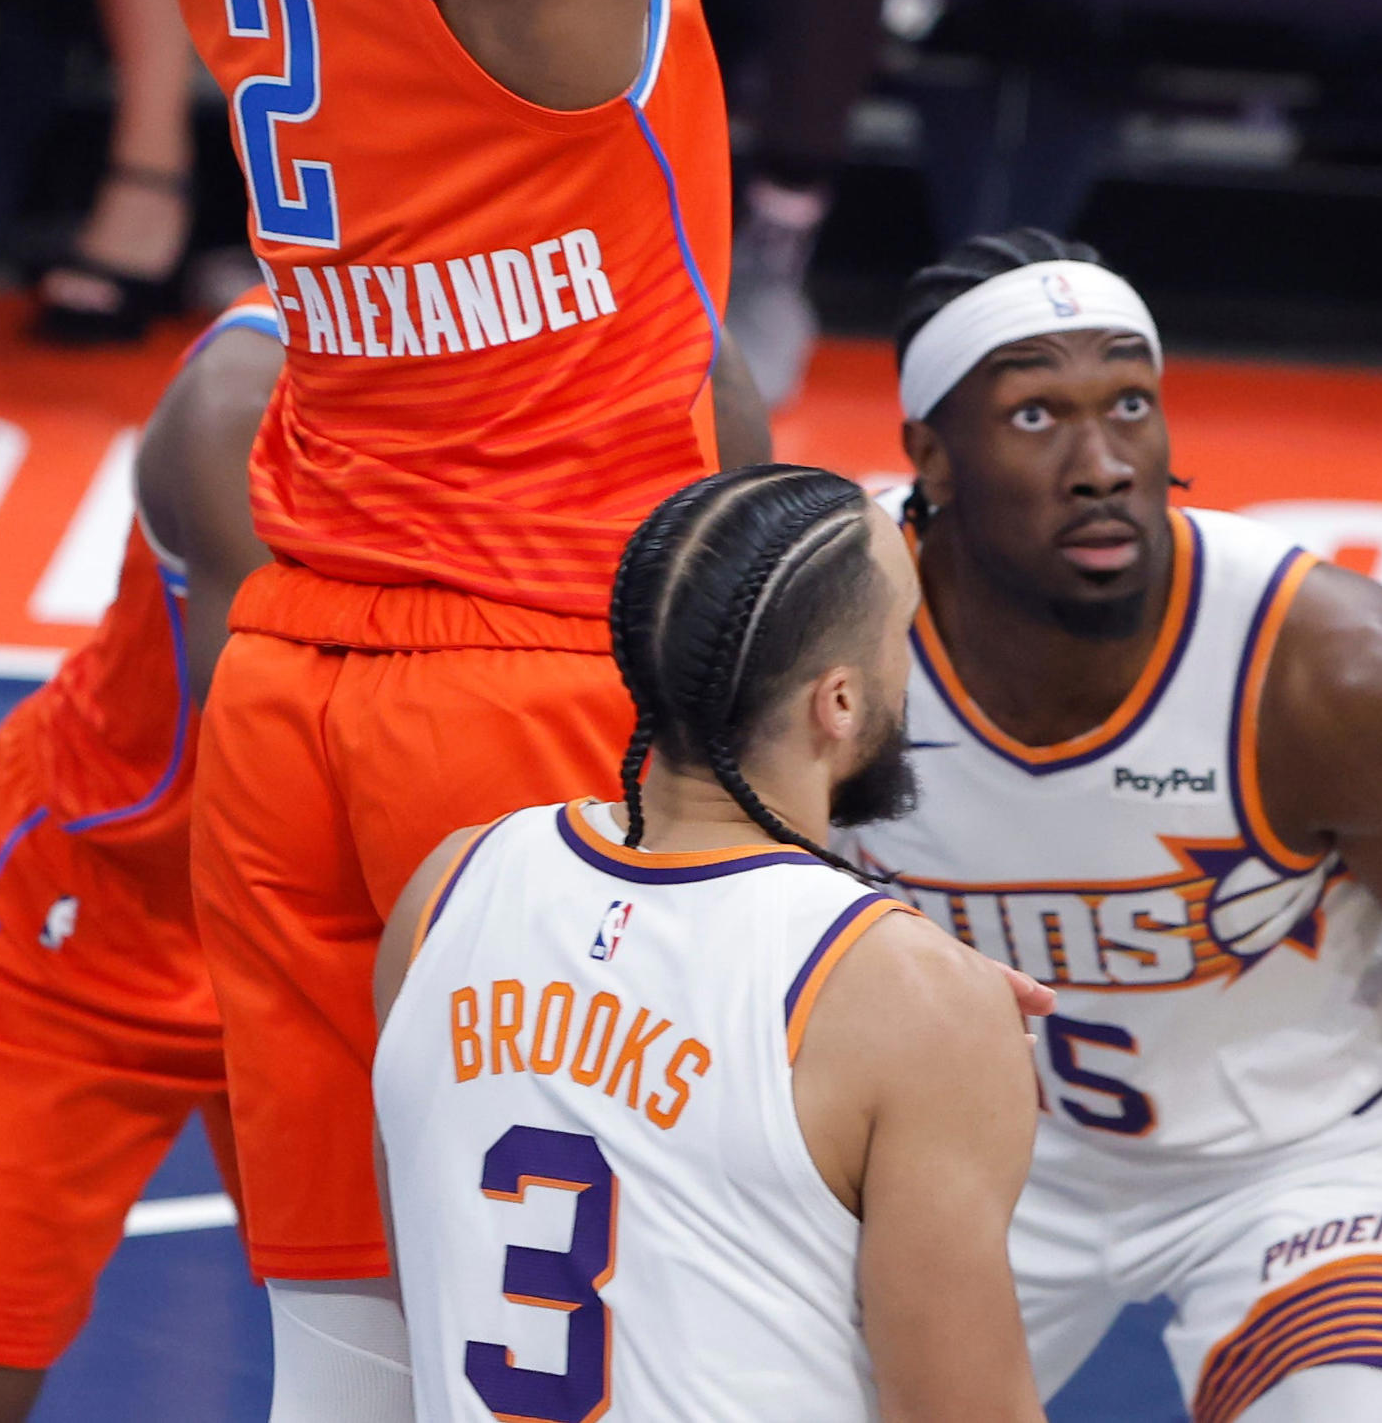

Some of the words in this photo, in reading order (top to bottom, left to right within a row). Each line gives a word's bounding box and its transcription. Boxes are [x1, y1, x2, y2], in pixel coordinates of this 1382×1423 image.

[257, 229, 618, 358] -ALEXANDER
[1114, 767, 1216, 798] PayPal
[899, 886, 1195, 984] UNS
[451, 979, 712, 1131] BROOKS
[1022, 1011, 1158, 1138] 5
[464, 1124, 620, 1423] 3
